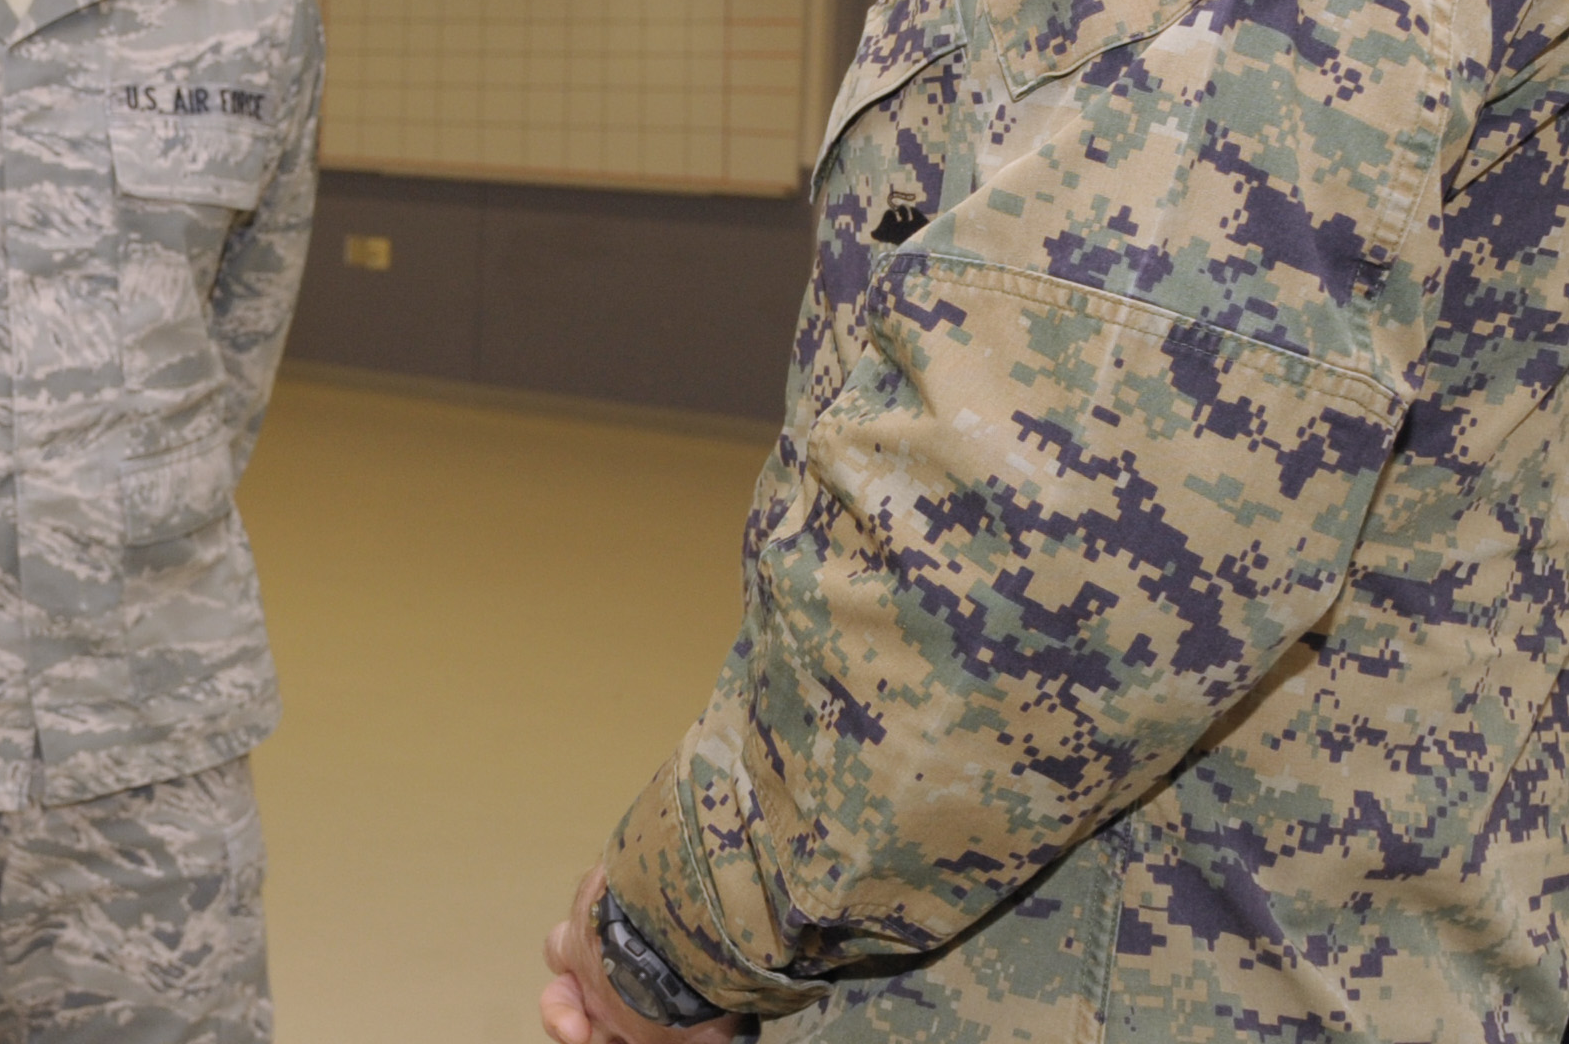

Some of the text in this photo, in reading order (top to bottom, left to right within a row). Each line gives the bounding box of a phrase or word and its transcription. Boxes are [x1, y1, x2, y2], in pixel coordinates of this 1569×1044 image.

[126, 86, 266, 121] U.S. AIR FORCE
